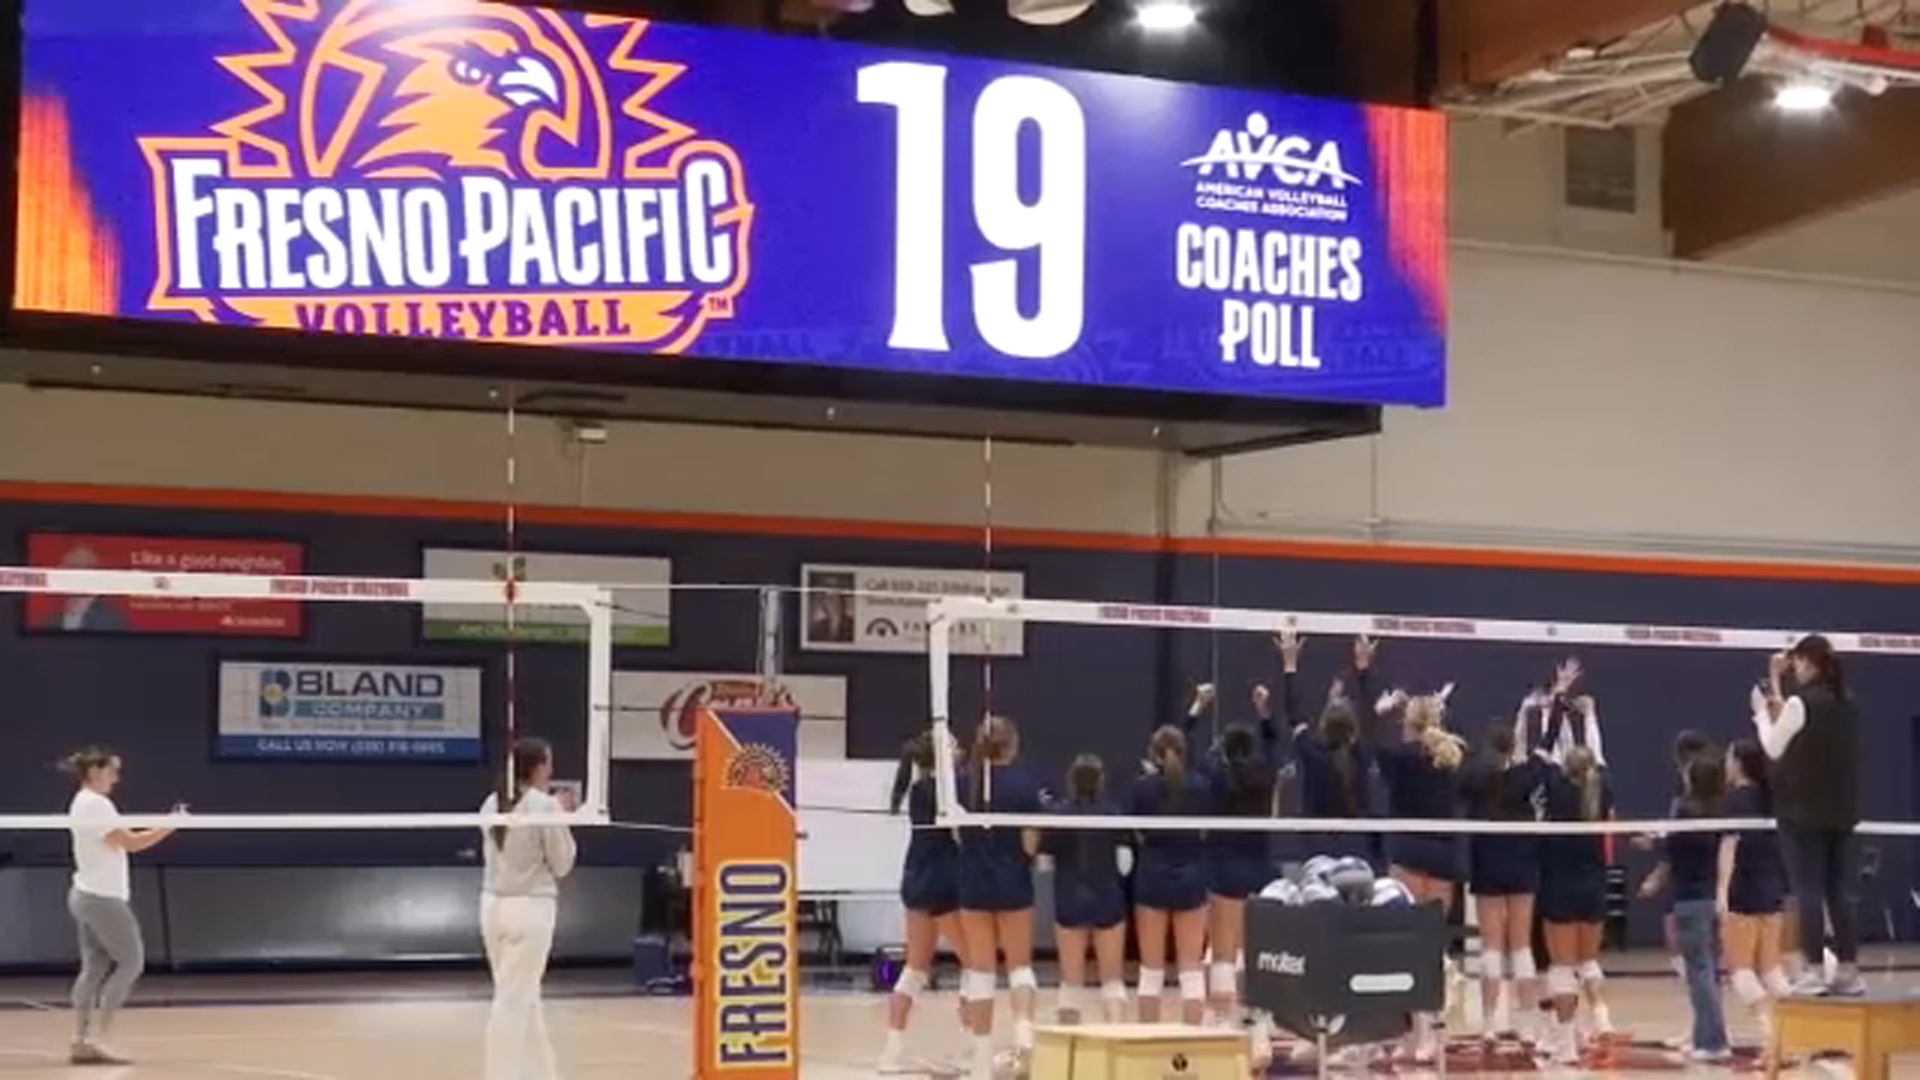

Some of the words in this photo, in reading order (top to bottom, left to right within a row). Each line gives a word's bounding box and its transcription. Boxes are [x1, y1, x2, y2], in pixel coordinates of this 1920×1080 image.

[1194, 124, 1353, 190] AVCA
[170, 157, 452, 289] FRESNO
[459, 158, 733, 286] PACIFIC
[857, 61, 1086, 358] 19
[1196, 181, 1264, 199] AMERICAN
[1268, 188, 1348, 208] VOLLEYBALL
[1176, 222, 1362, 303] COACHES
[296, 298, 631, 337] VOLLEYBALL
[1220, 299, 1321, 370] POLL
[297, 671, 444, 697] BLAND
[312, 702, 425, 721] COMPANY
[720, 864, 787, 1062] FRESNO
